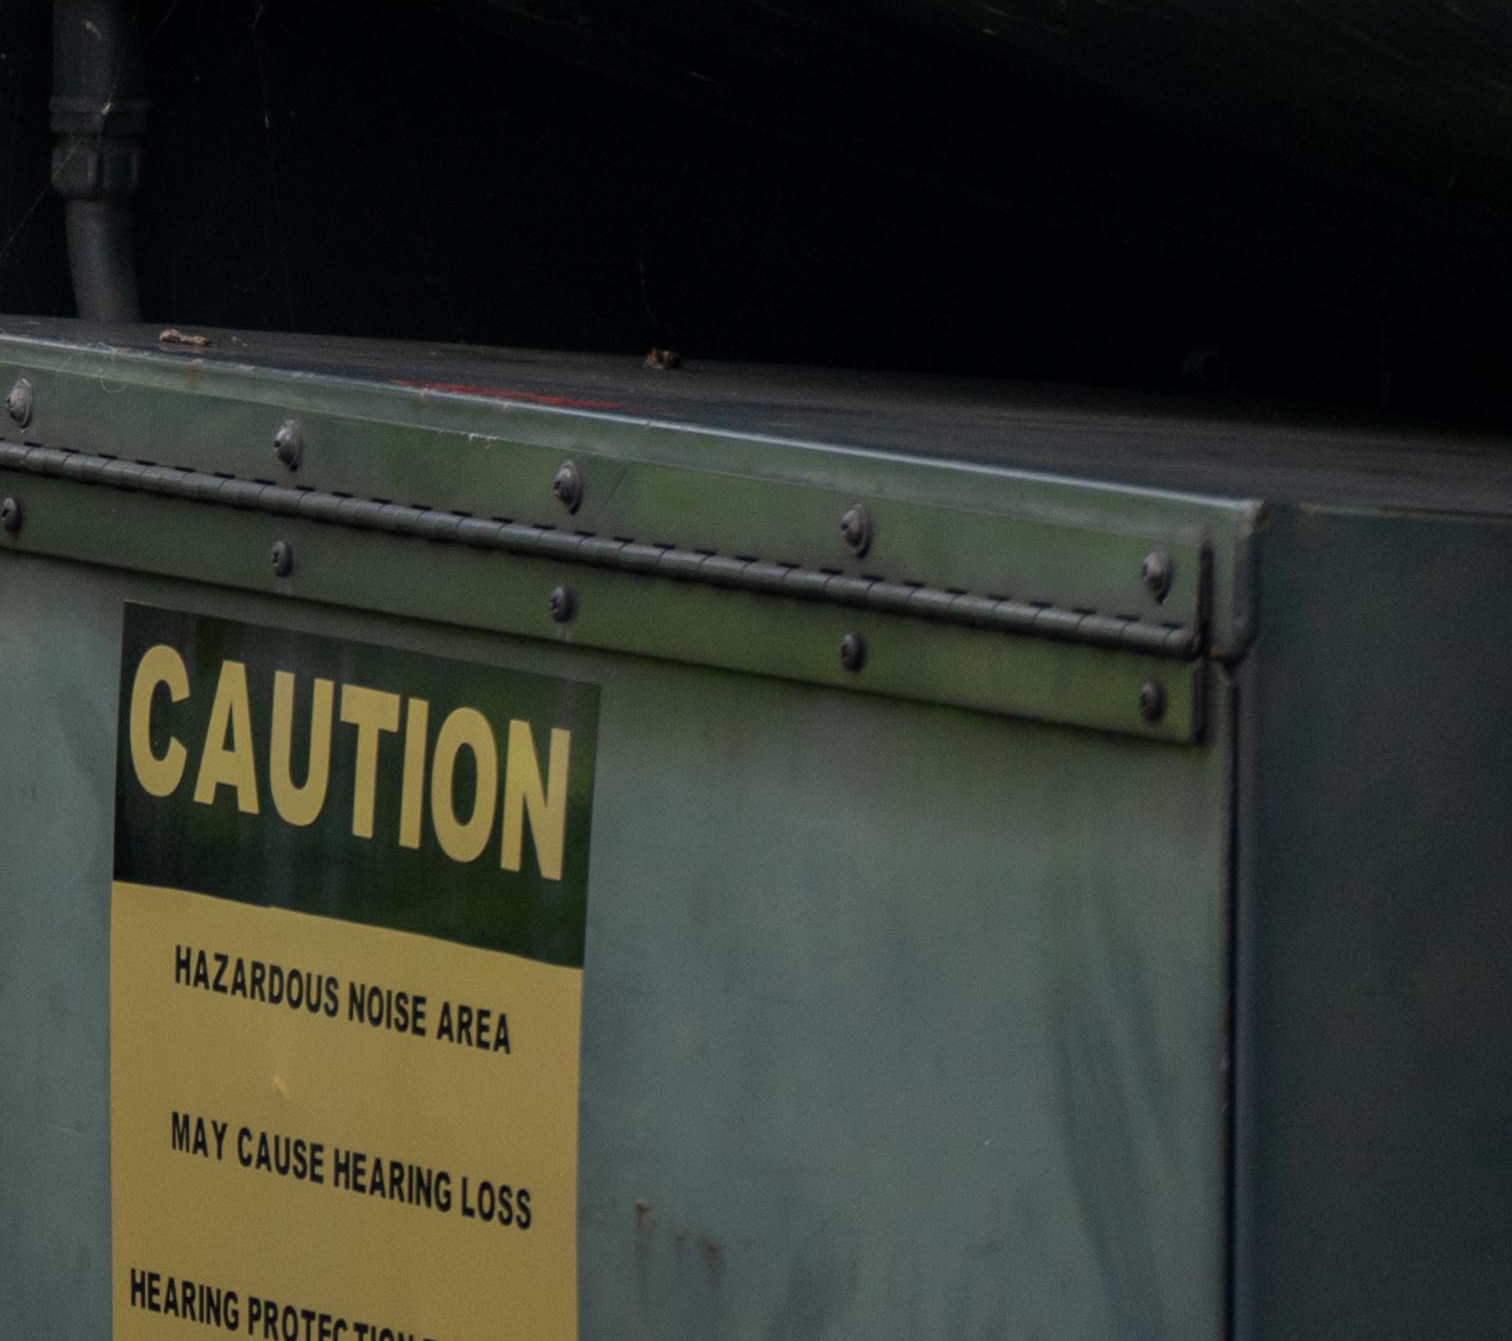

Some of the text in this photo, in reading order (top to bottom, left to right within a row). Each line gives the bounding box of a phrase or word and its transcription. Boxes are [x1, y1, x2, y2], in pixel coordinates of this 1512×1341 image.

[129, 644, 571, 882] CAUTION
[174, 944, 511, 1055] HAZARDOUS NOISE AREA
[171, 1110, 532, 1232] MAY CAUSE HEARING LOSS
[129, 1268, 239, 1331] HEARING
